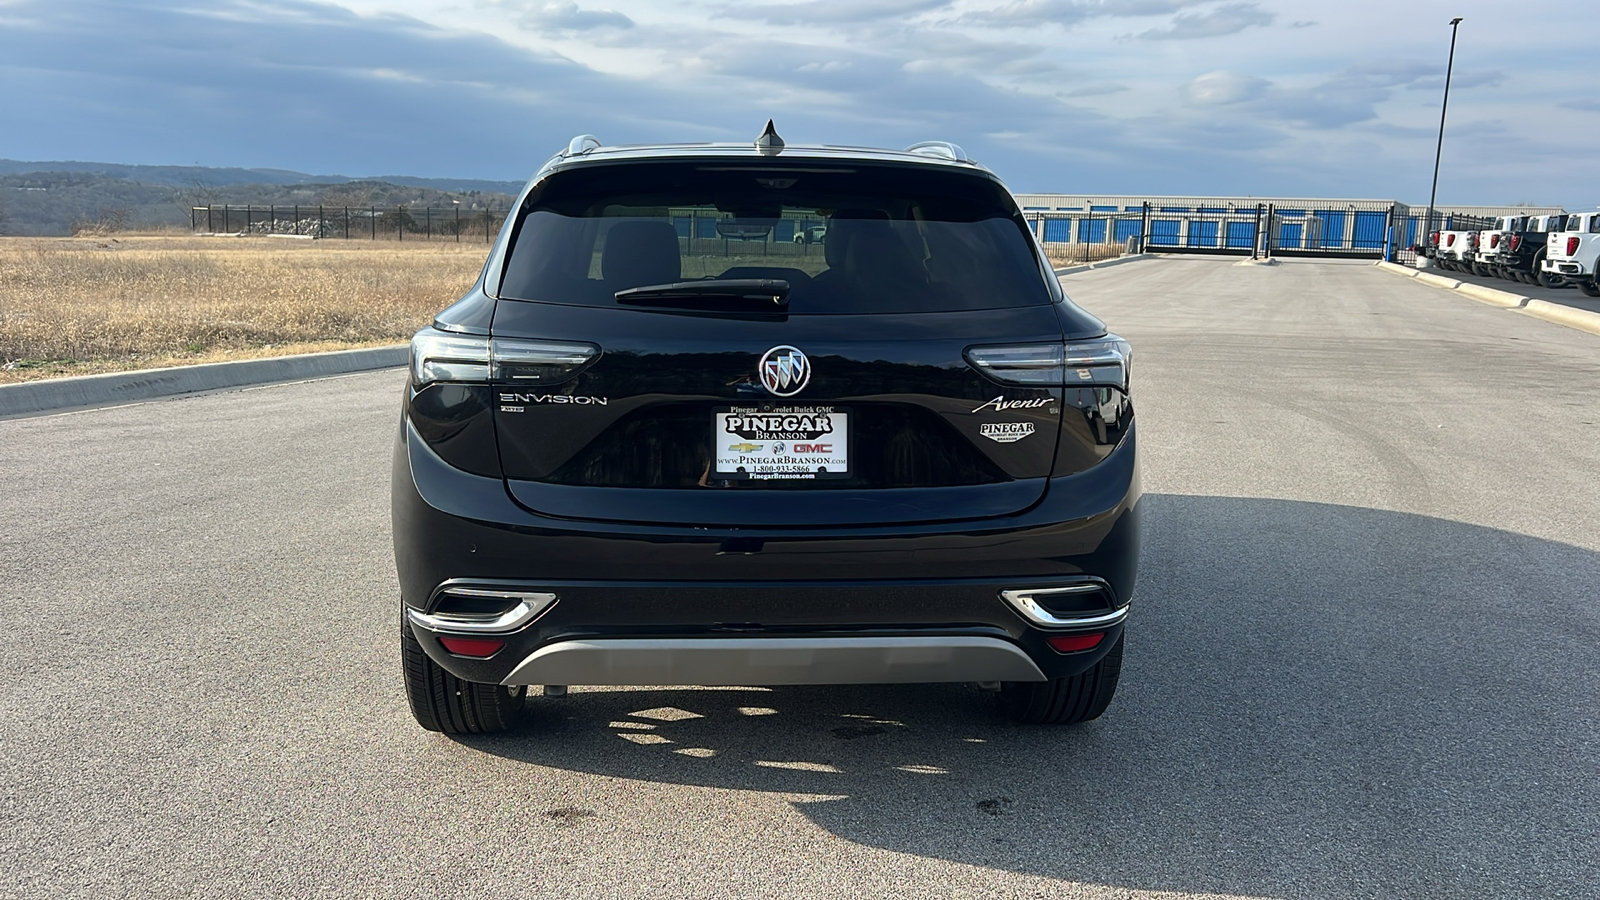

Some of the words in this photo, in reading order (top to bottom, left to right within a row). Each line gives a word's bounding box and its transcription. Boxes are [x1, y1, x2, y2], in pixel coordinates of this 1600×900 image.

[499, 392, 608, 406] ENVISION
[971, 395, 1055, 413] Avenir
[730, 406, 758, 414] Pinegar
[727, 417, 832, 431] PINEGAR
[981, 423, 1034, 433] PINEGAR
[755, 430, 808, 440] BRANSON
[793, 444, 833, 453] GMC
